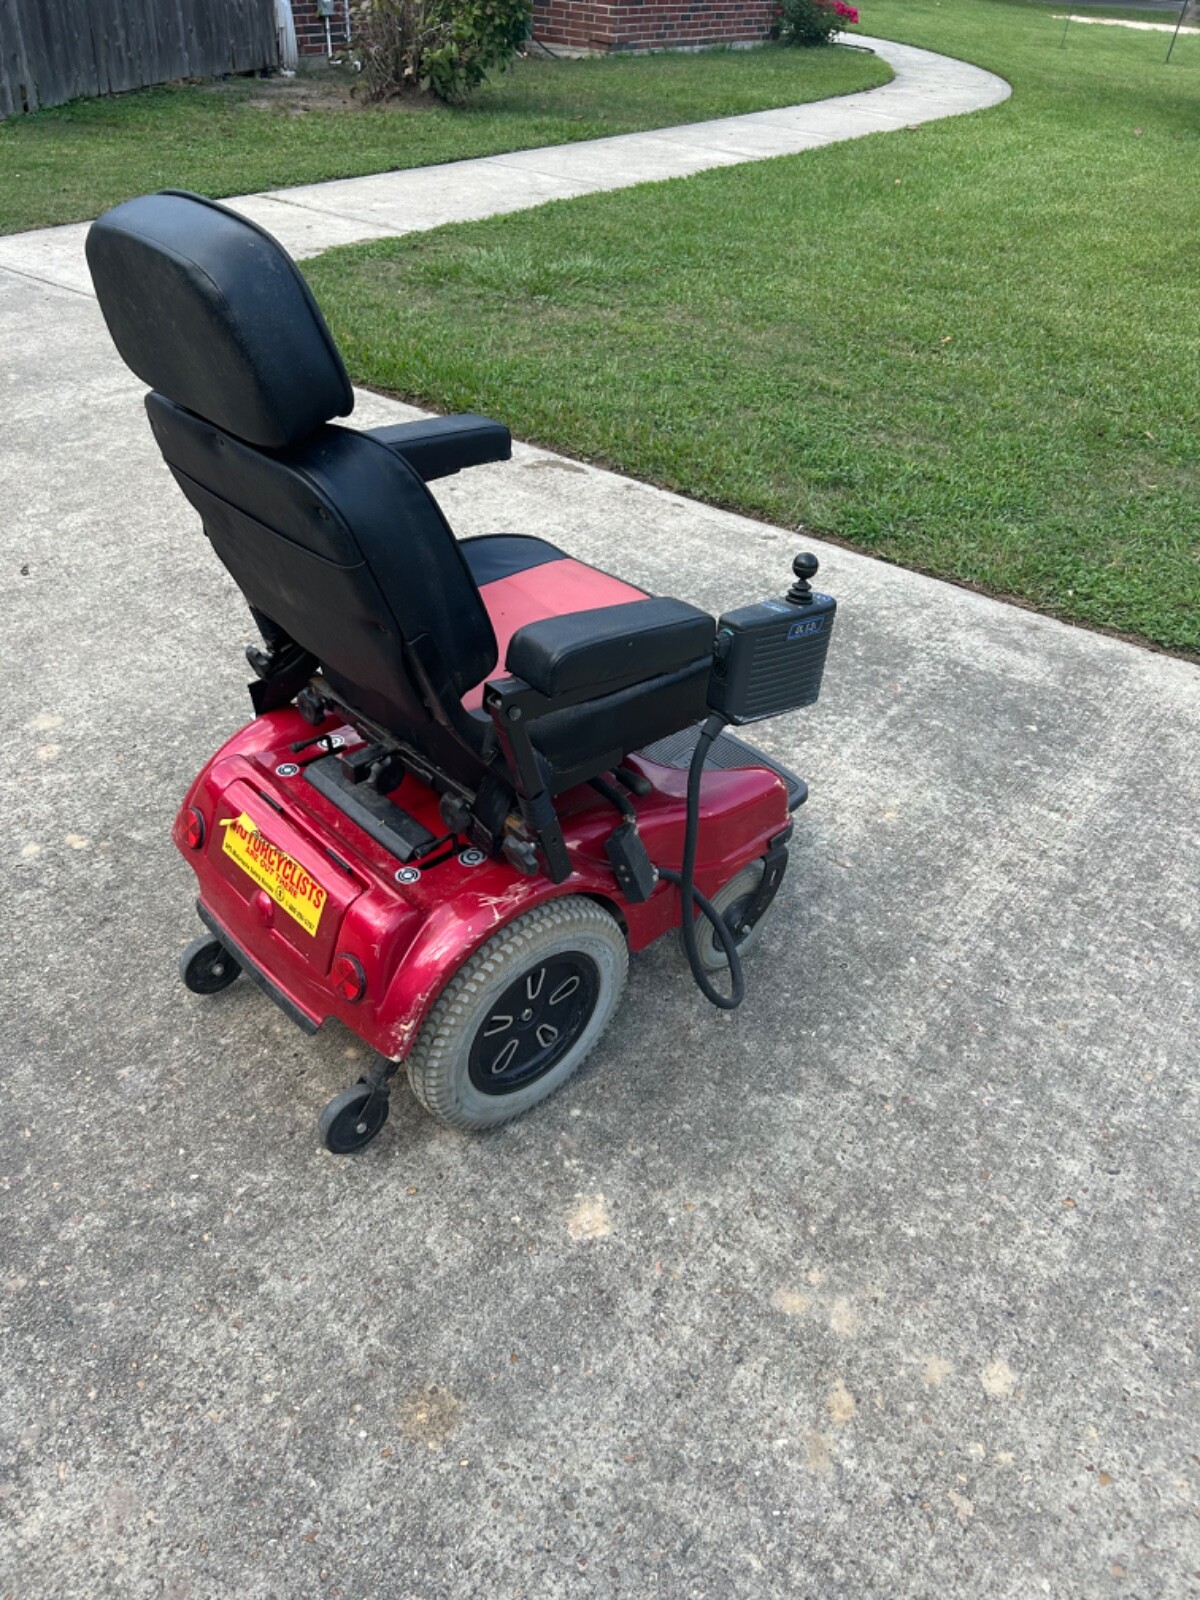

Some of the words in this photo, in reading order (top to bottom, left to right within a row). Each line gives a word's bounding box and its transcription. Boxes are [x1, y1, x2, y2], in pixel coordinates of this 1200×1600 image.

[245, 846, 258, 863] ARE
[260, 859, 275, 875] OUT
[275, 872, 298, 898] THERE
